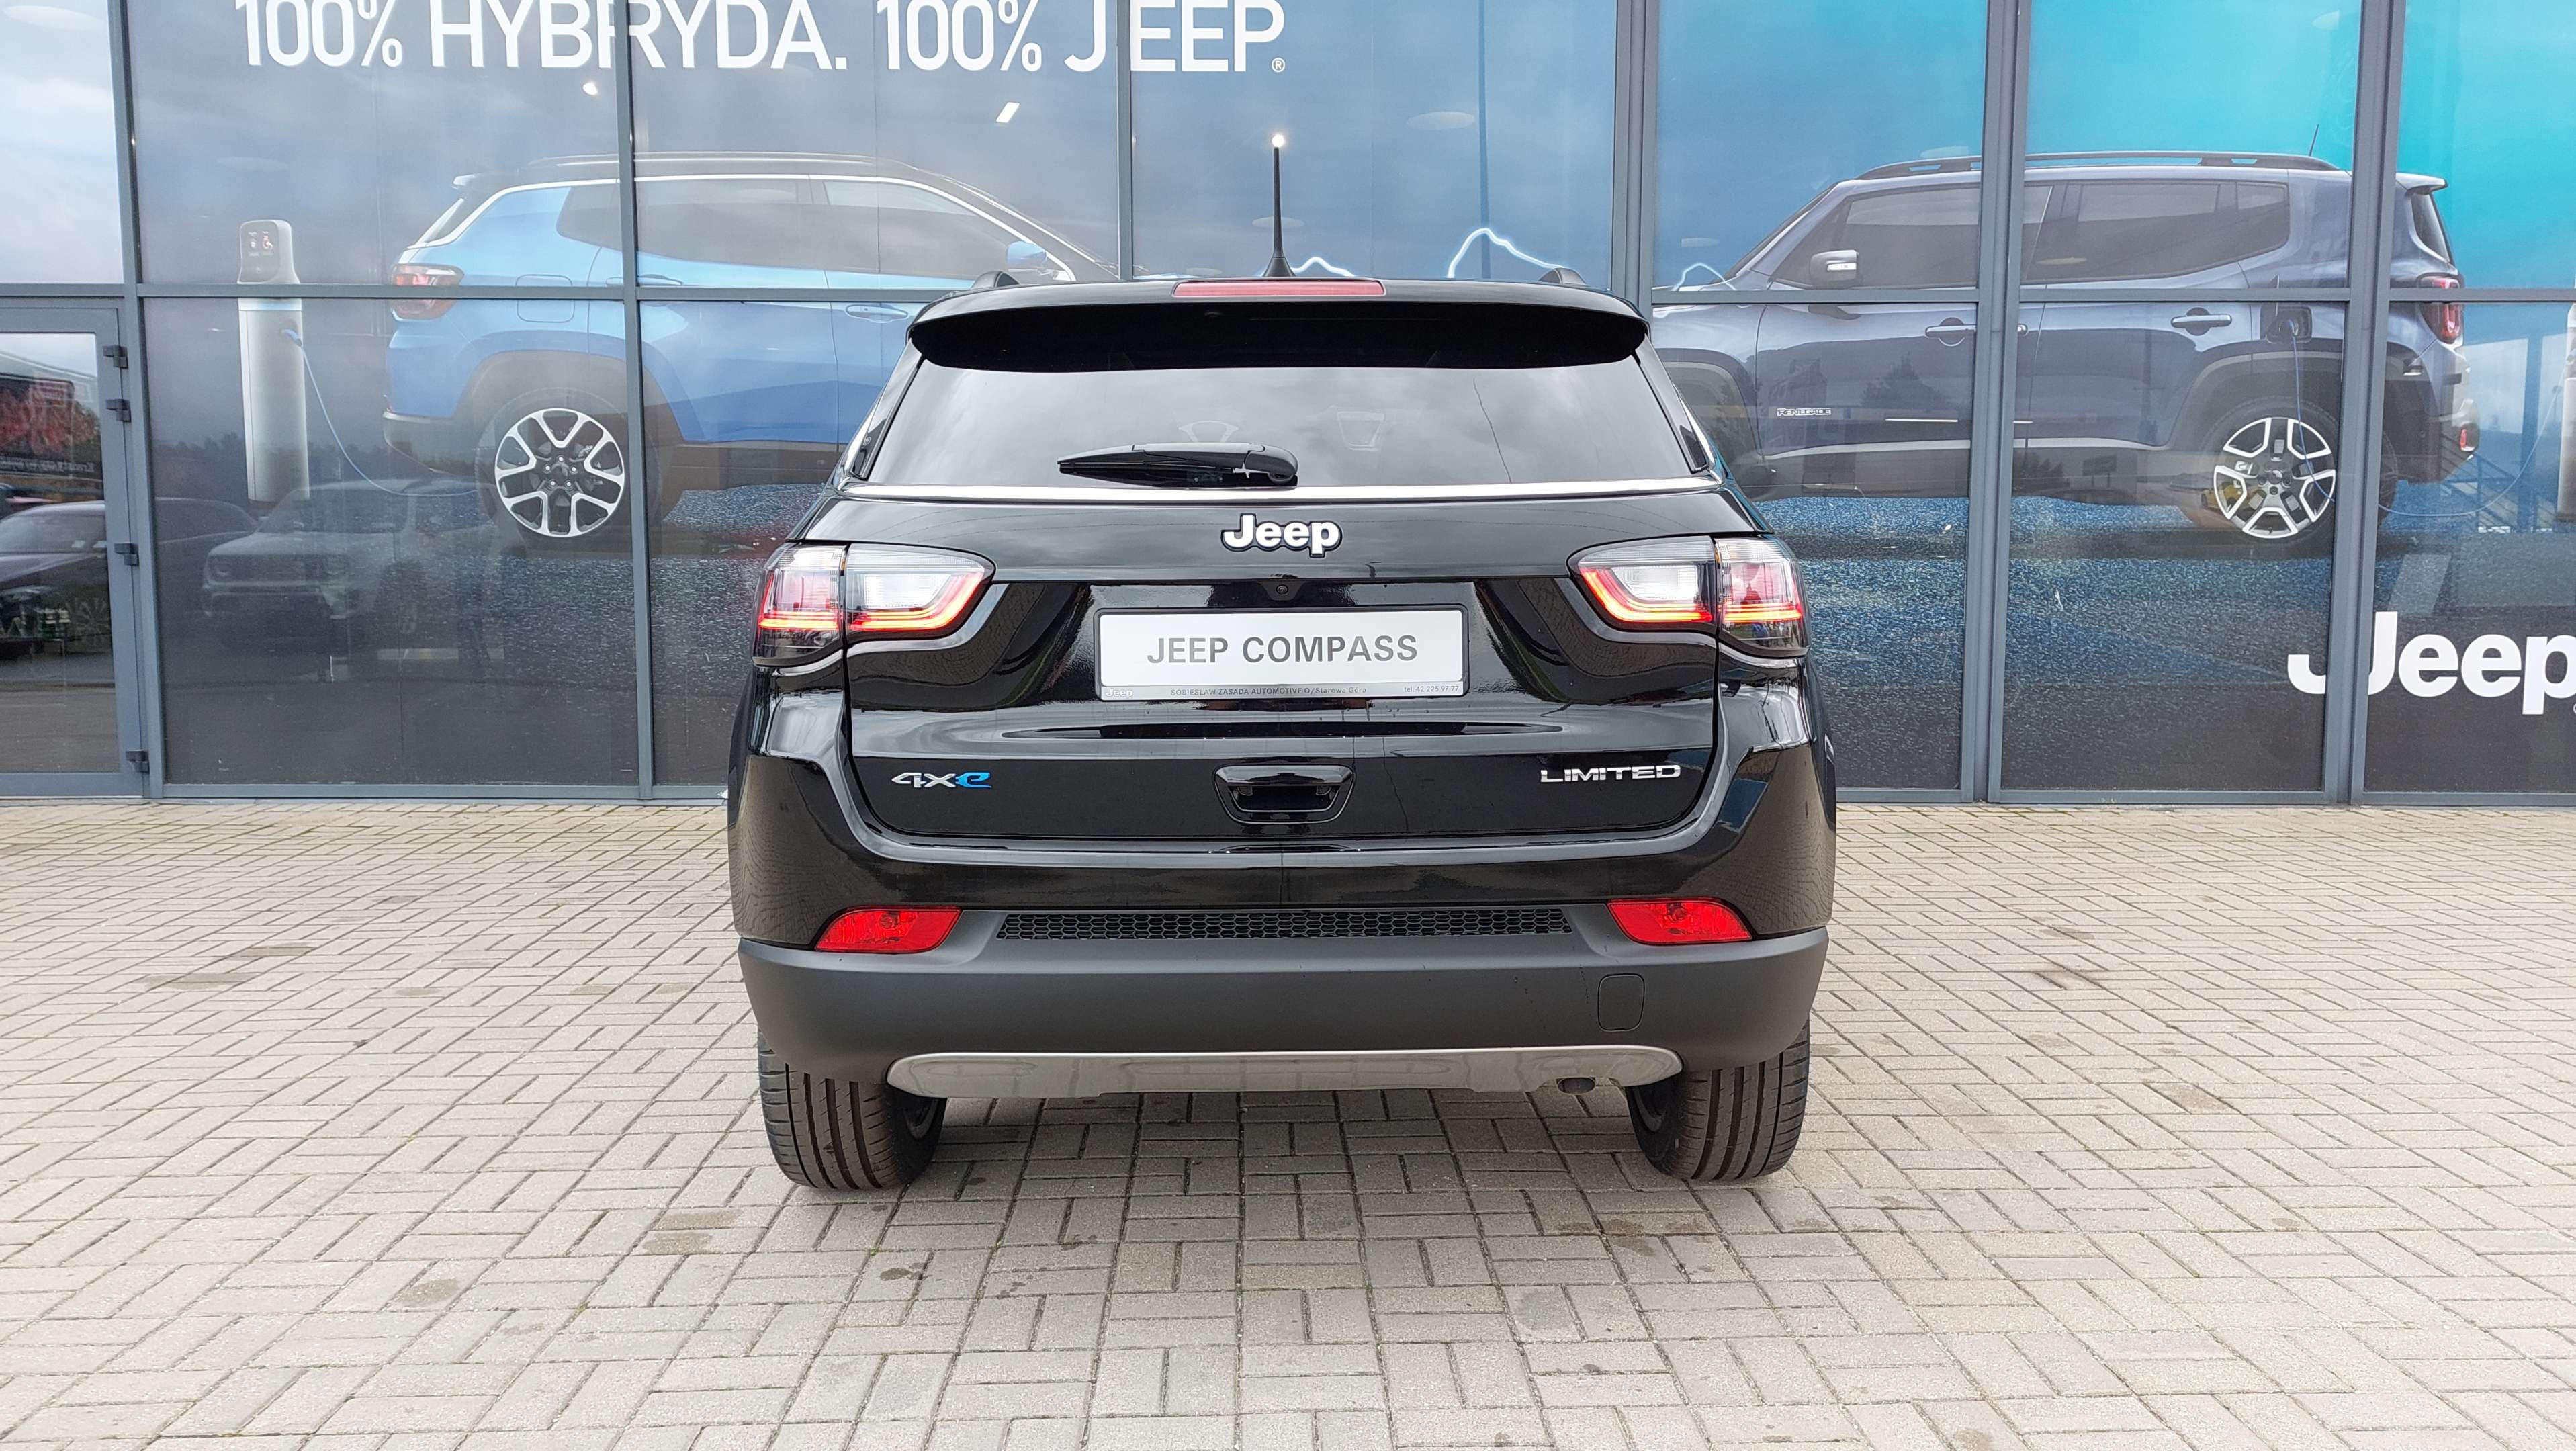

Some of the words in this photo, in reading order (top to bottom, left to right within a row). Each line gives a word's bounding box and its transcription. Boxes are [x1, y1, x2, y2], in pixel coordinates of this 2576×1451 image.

[236, 0, 403, 67] 100%
[432, 0, 847, 70] HYBRYDA.
[877, 0, 1042, 71] 100%
[1777, 408, 1832, 416] RENEGADE
[1221, 513, 1342, 558] Jeep
[1147, 637, 1228, 663] JEEP
[1243, 635, 1418, 663] COMPASS
[2287, 611, 2576, 715] Jeep
[1106, 688, 1133, 699] Jeep
[1540, 764, 1681, 783] LIMITED
